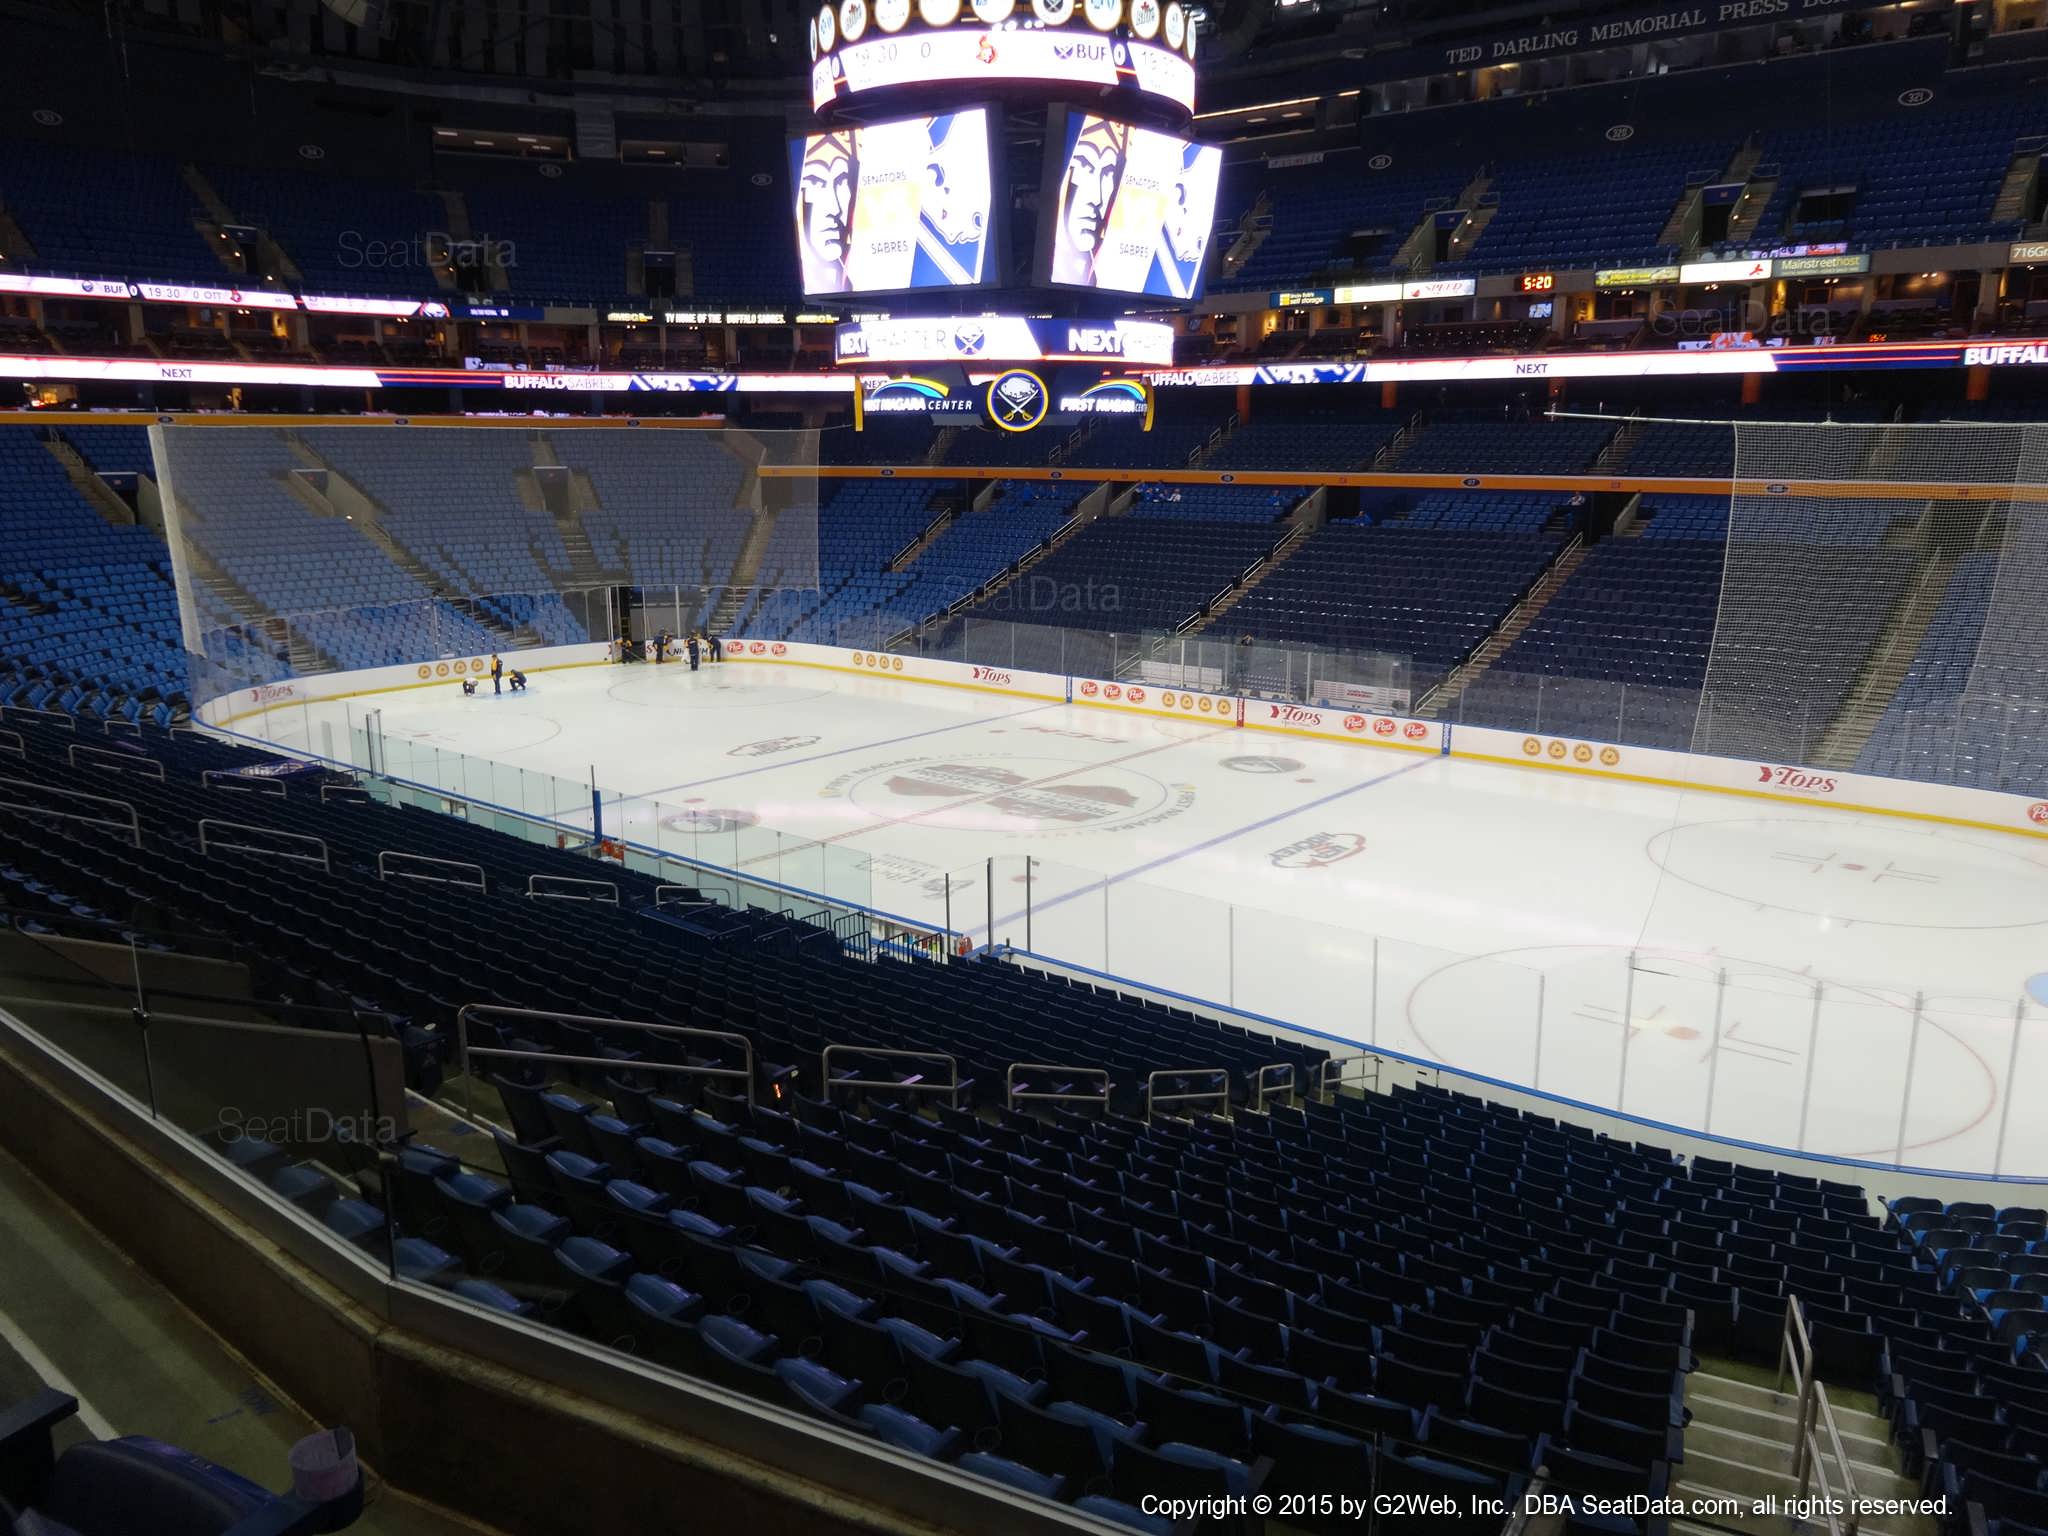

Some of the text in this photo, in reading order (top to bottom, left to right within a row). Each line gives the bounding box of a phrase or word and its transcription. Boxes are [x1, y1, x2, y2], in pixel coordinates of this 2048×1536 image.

[1447, 0, 1790, 65] TED DARLING MEMORIAL PRESS
[1076, 43, 1109, 61] BUF
[862, 171, 907, 185] SENATORS
[871, 242, 909, 255] SABRES
[1119, 243, 1149, 258] SABRES
[104, 284, 124, 294] BUF
[1524, 275, 1552, 290] 5:20
[1068, 329, 1123, 353] NEXT
[162, 367, 193, 380] NEXT
[1516, 363, 1549, 375] NEXT
[504, 375, 615, 389] BUFFALO SABRES
[1197, 371, 1239, 385] SABRES
[928, 400, 973, 410] CENTER
